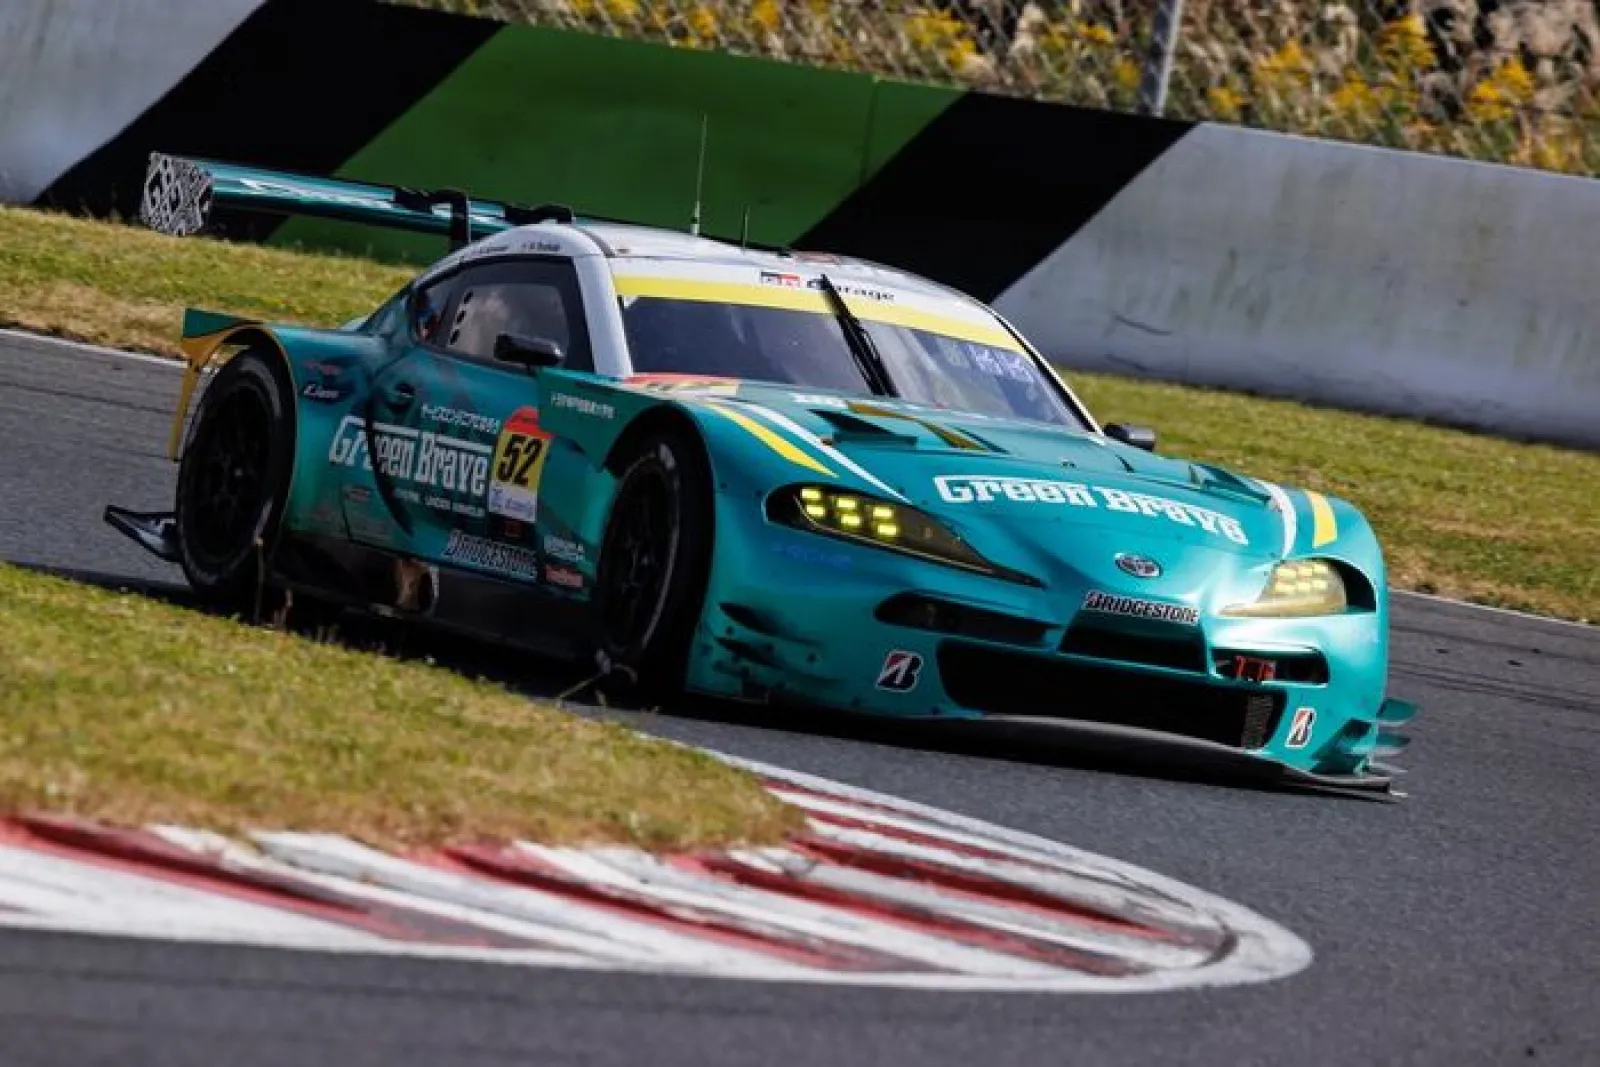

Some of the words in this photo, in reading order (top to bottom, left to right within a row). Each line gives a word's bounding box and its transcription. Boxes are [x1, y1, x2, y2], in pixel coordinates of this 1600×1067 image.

[806, 278, 895, 301] Grage
[414, 431, 493, 497] Brave
[498, 434, 542, 486] 52
[933, 475, 1097, 507] Green
[1092, 486, 1248, 546] Brave
[1081, 590, 1200, 626] BRIDGESTONE
